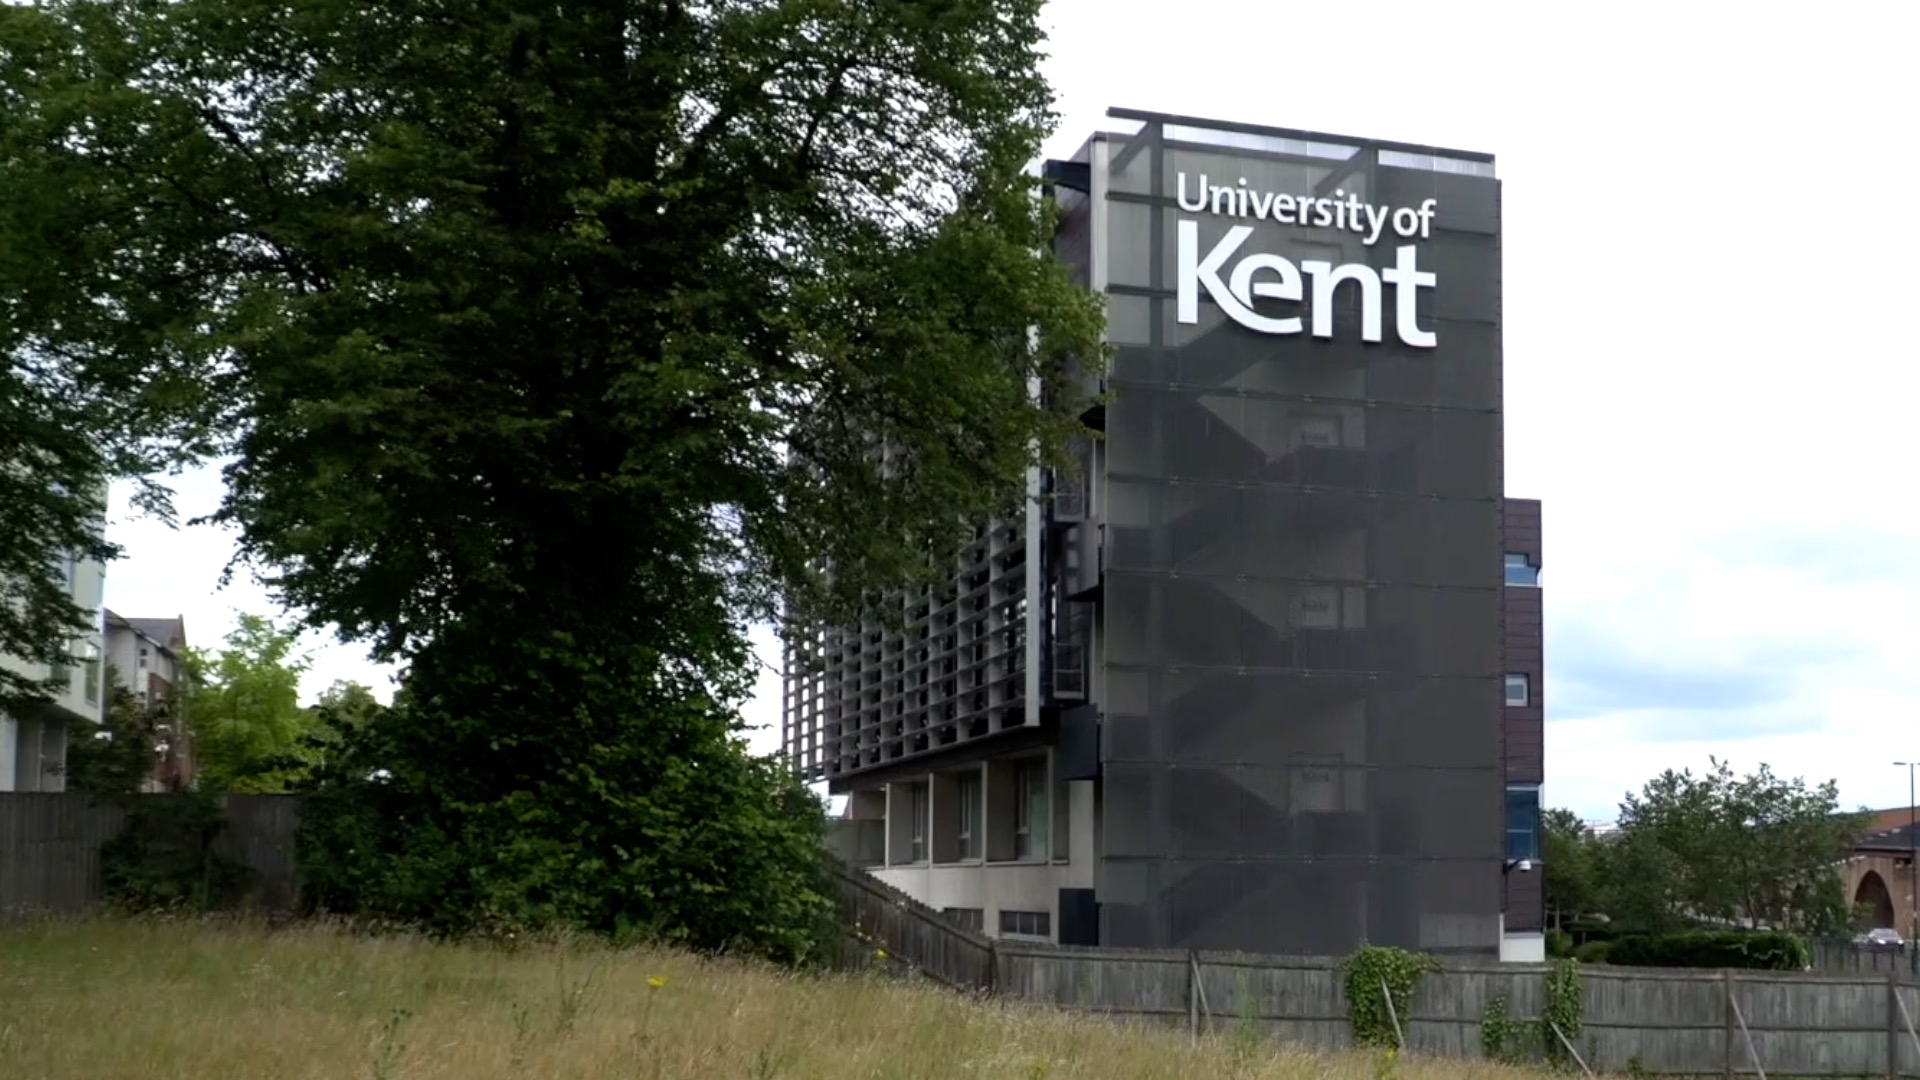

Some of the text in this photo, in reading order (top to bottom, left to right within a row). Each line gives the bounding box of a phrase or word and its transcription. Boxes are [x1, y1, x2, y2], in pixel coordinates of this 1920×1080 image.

[1178, 172, 1437, 245] University of
[1177, 219, 1437, 347] Kent
